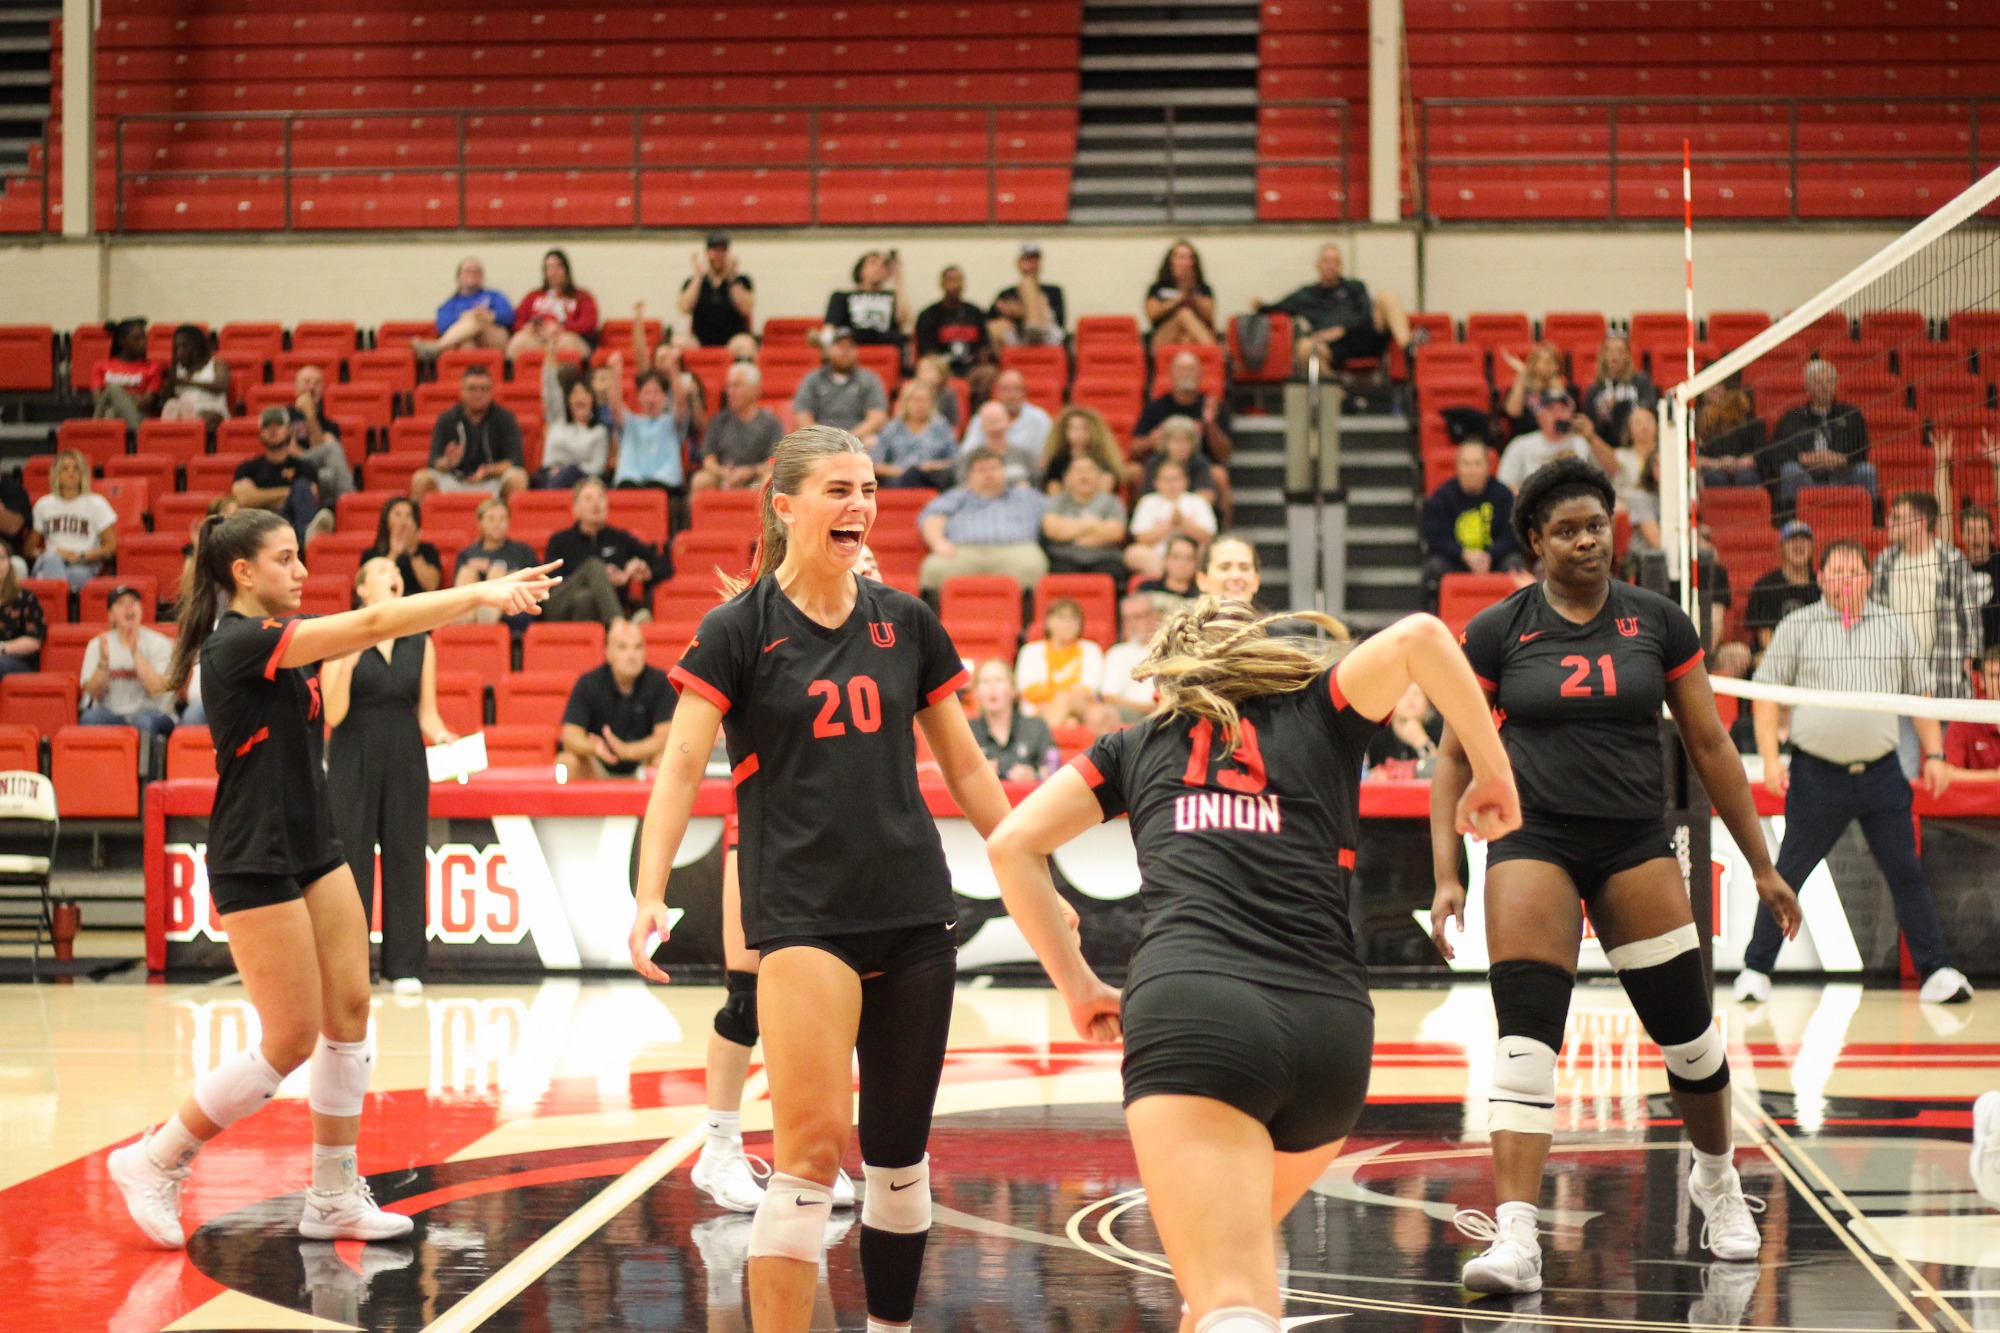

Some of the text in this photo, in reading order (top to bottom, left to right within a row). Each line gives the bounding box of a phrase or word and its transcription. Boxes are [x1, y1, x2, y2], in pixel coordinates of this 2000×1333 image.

[42, 515, 90, 538] UNION
[868, 621, 897, 648] U
[1614, 616, 1639, 637] U
[1560, 654, 1617, 697] 21
[807, 674, 882, 738] 20
[0, 776, 39, 799] NION
[1174, 793, 1281, 834] UNION
